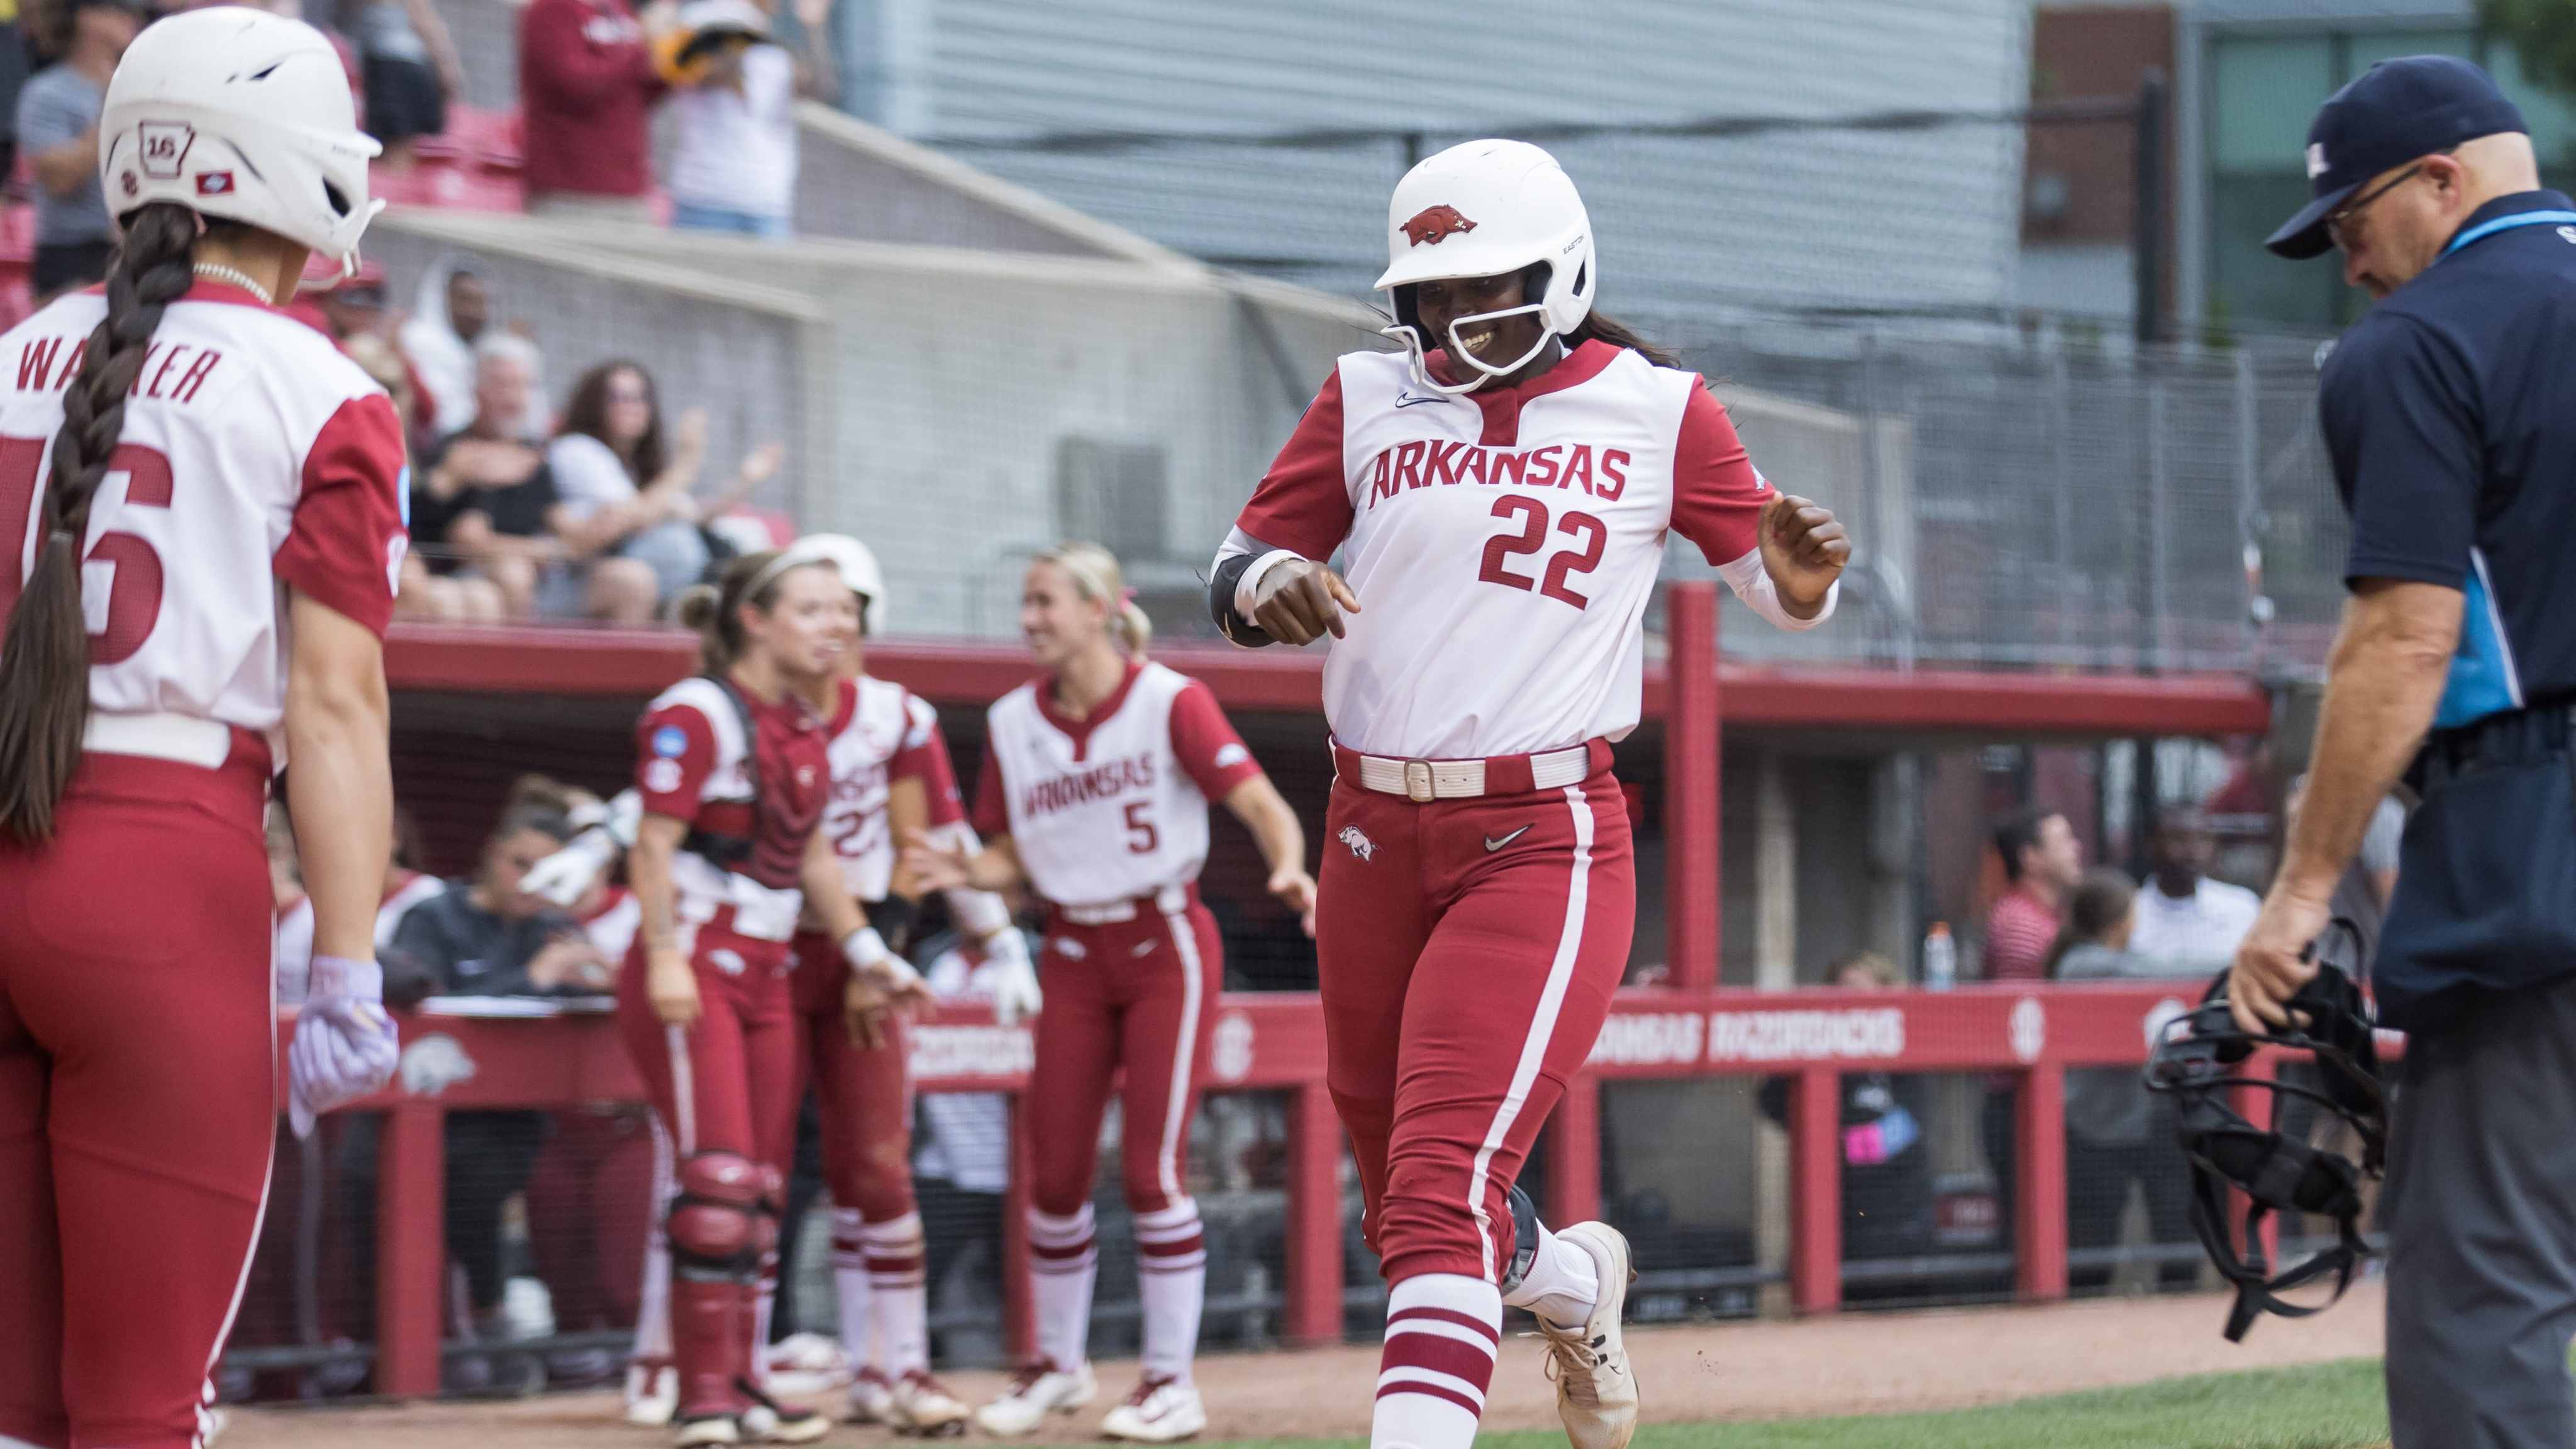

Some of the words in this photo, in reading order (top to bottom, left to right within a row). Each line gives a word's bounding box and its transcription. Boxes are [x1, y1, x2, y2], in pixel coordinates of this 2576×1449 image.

[148, 135, 176, 158] 16
[17, 337, 222, 404] WAKER
[1368, 439, 1630, 510] ARKANSAS
[1478, 494, 1607, 611] 22
[1122, 798, 1159, 855] 5
